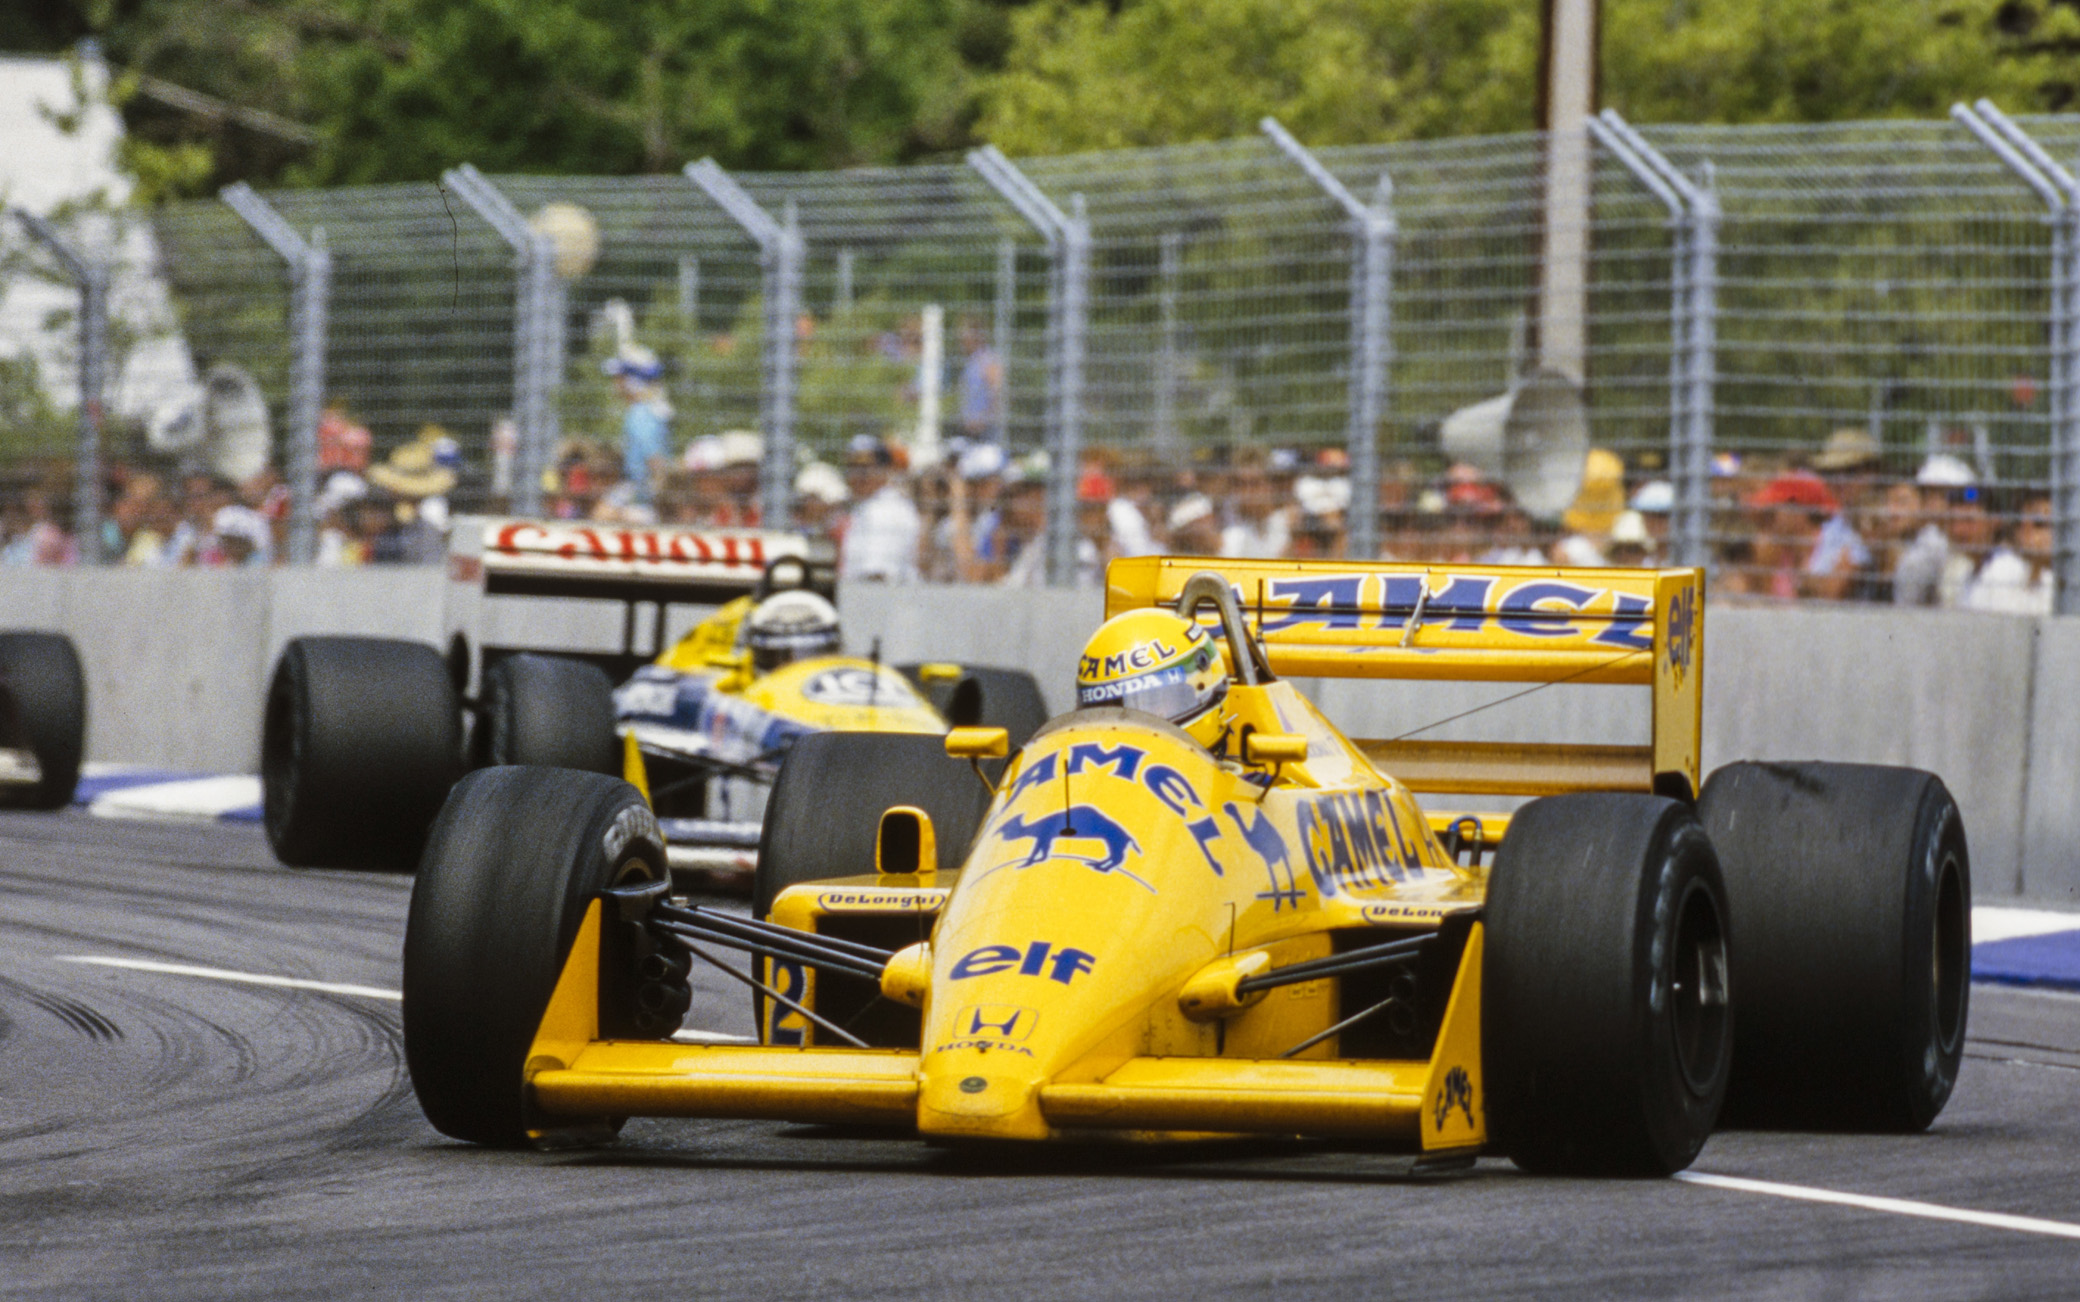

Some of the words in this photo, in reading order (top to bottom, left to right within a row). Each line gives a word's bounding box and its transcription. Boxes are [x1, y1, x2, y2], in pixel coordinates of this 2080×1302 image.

[498, 523, 765, 570] Canon
[1667, 586, 1694, 666] elf
[1082, 674, 1163, 703] HONDA
[1296, 787, 1425, 897] CAMEL
[829, 893, 937, 908] DeLonghi
[1372, 906, 1444, 917] DeLon
[949, 940, 1097, 985] elf
